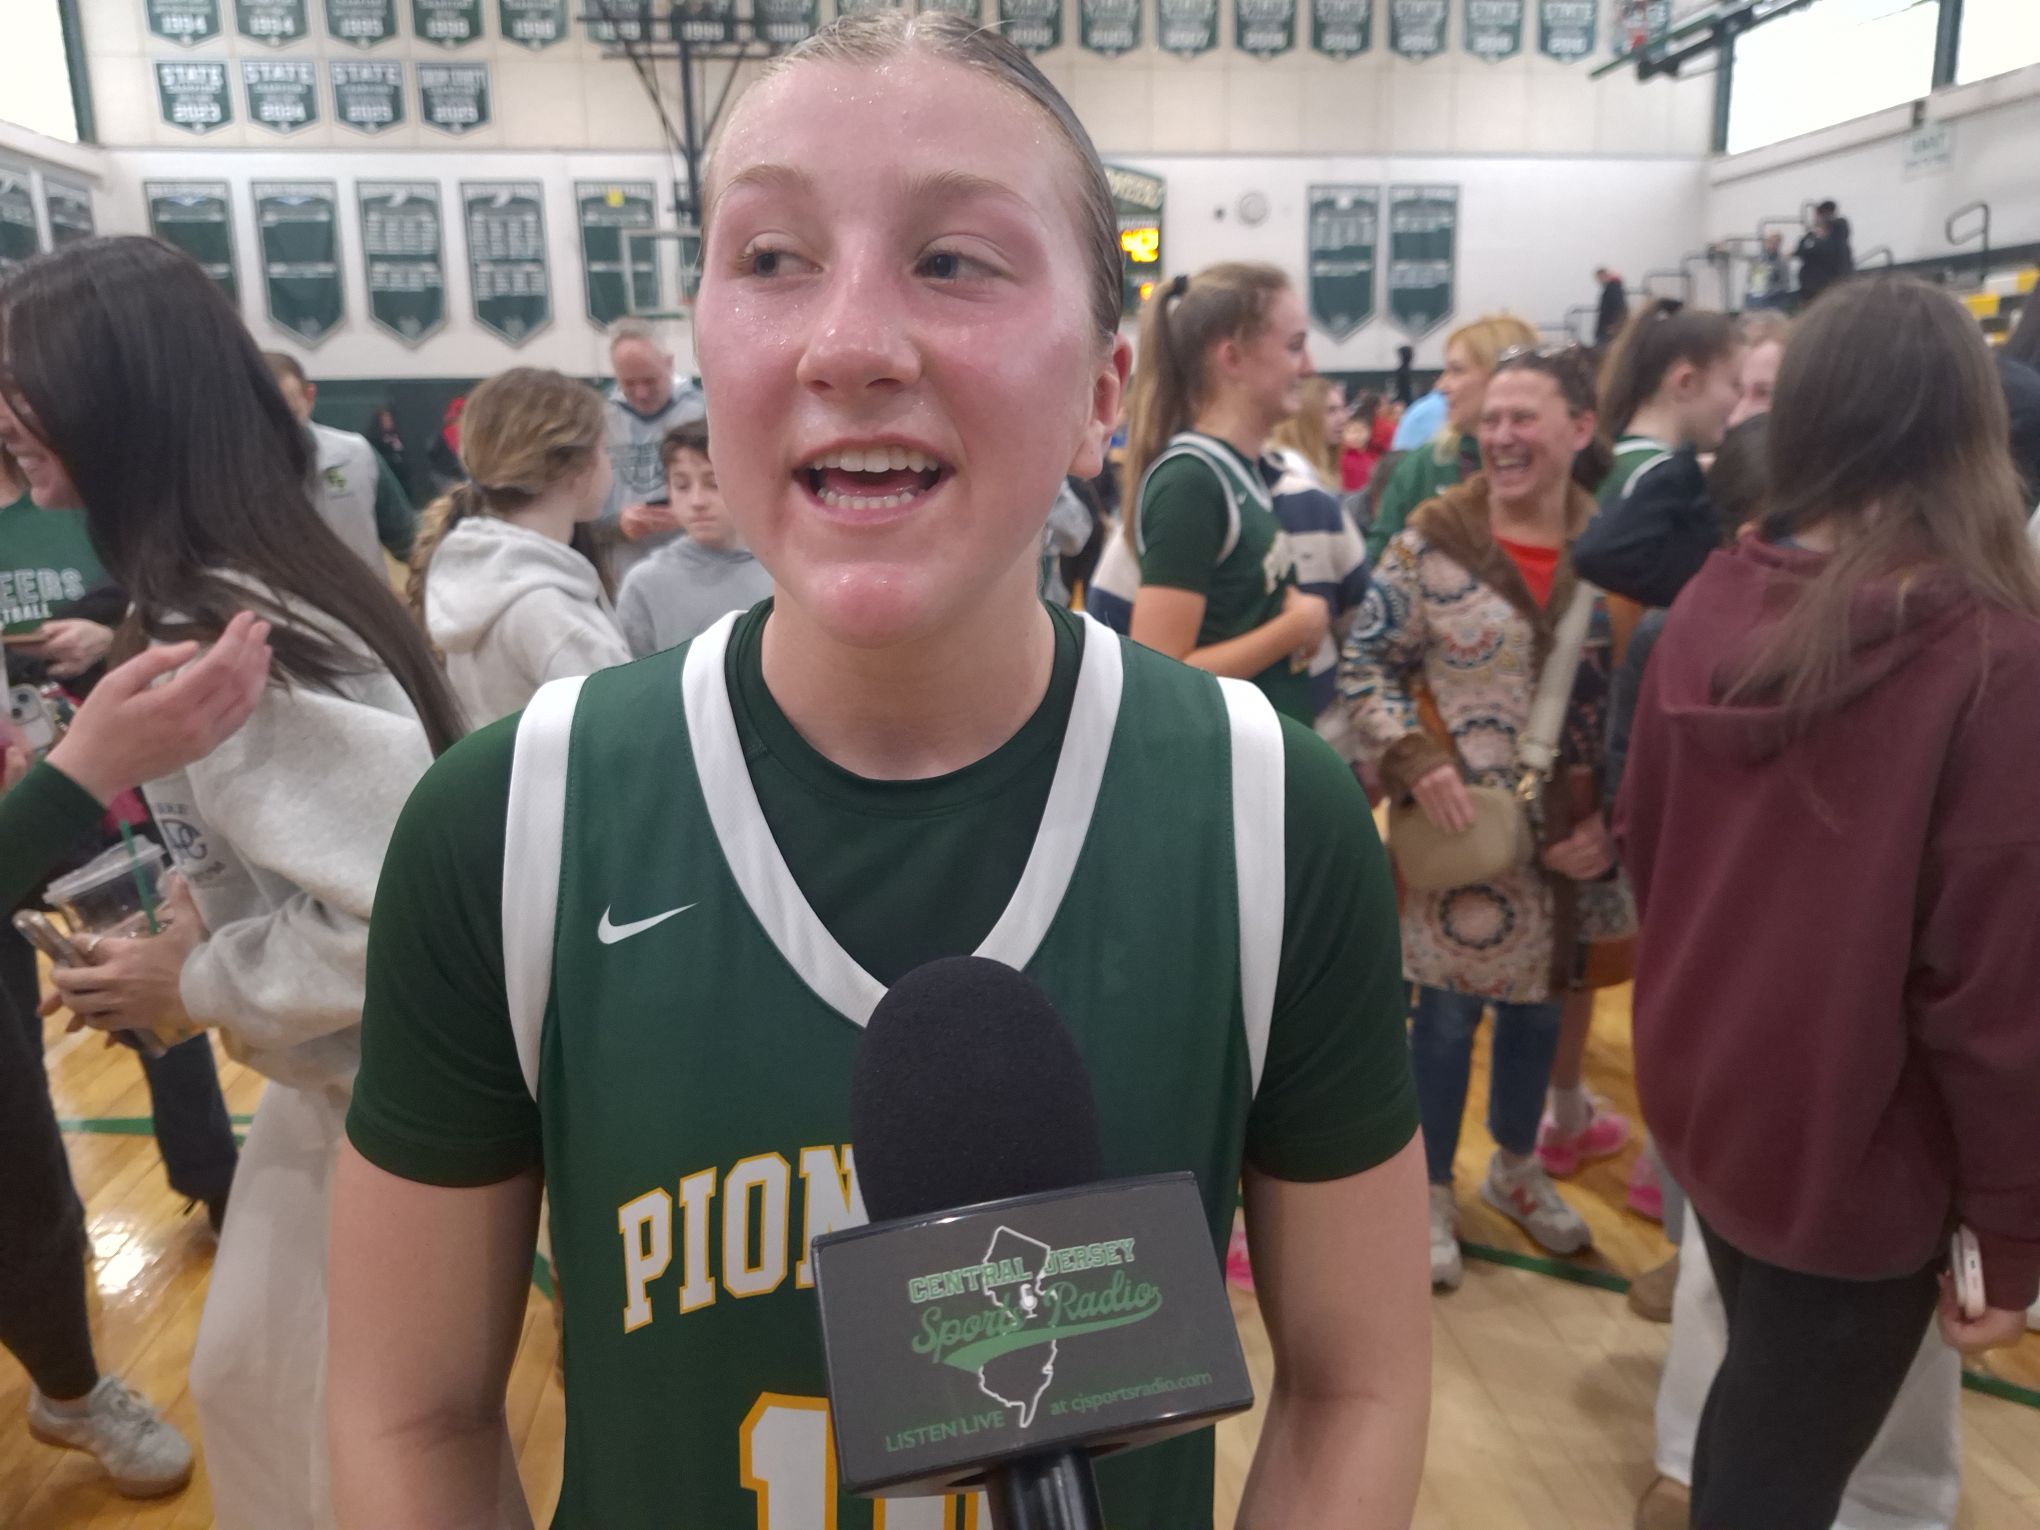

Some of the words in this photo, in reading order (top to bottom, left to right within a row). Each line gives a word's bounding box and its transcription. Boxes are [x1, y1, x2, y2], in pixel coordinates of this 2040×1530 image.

[161, 64, 223, 86] STATE
[246, 62, 314, 85] STATE
[908, 1257, 1033, 1304] CENTRAL
[1044, 1238, 1136, 1276] JERSEY
[911, 1293, 1025, 1364] Sports
[1044, 1269, 1160, 1326] Radio
[1050, 1399, 1069, 1416] at
[1071, 1371, 1213, 1414] cjsportsradio.com
[885, 1421, 957, 1453] LISTEN
[961, 1410, 1006, 1436] LIVE
